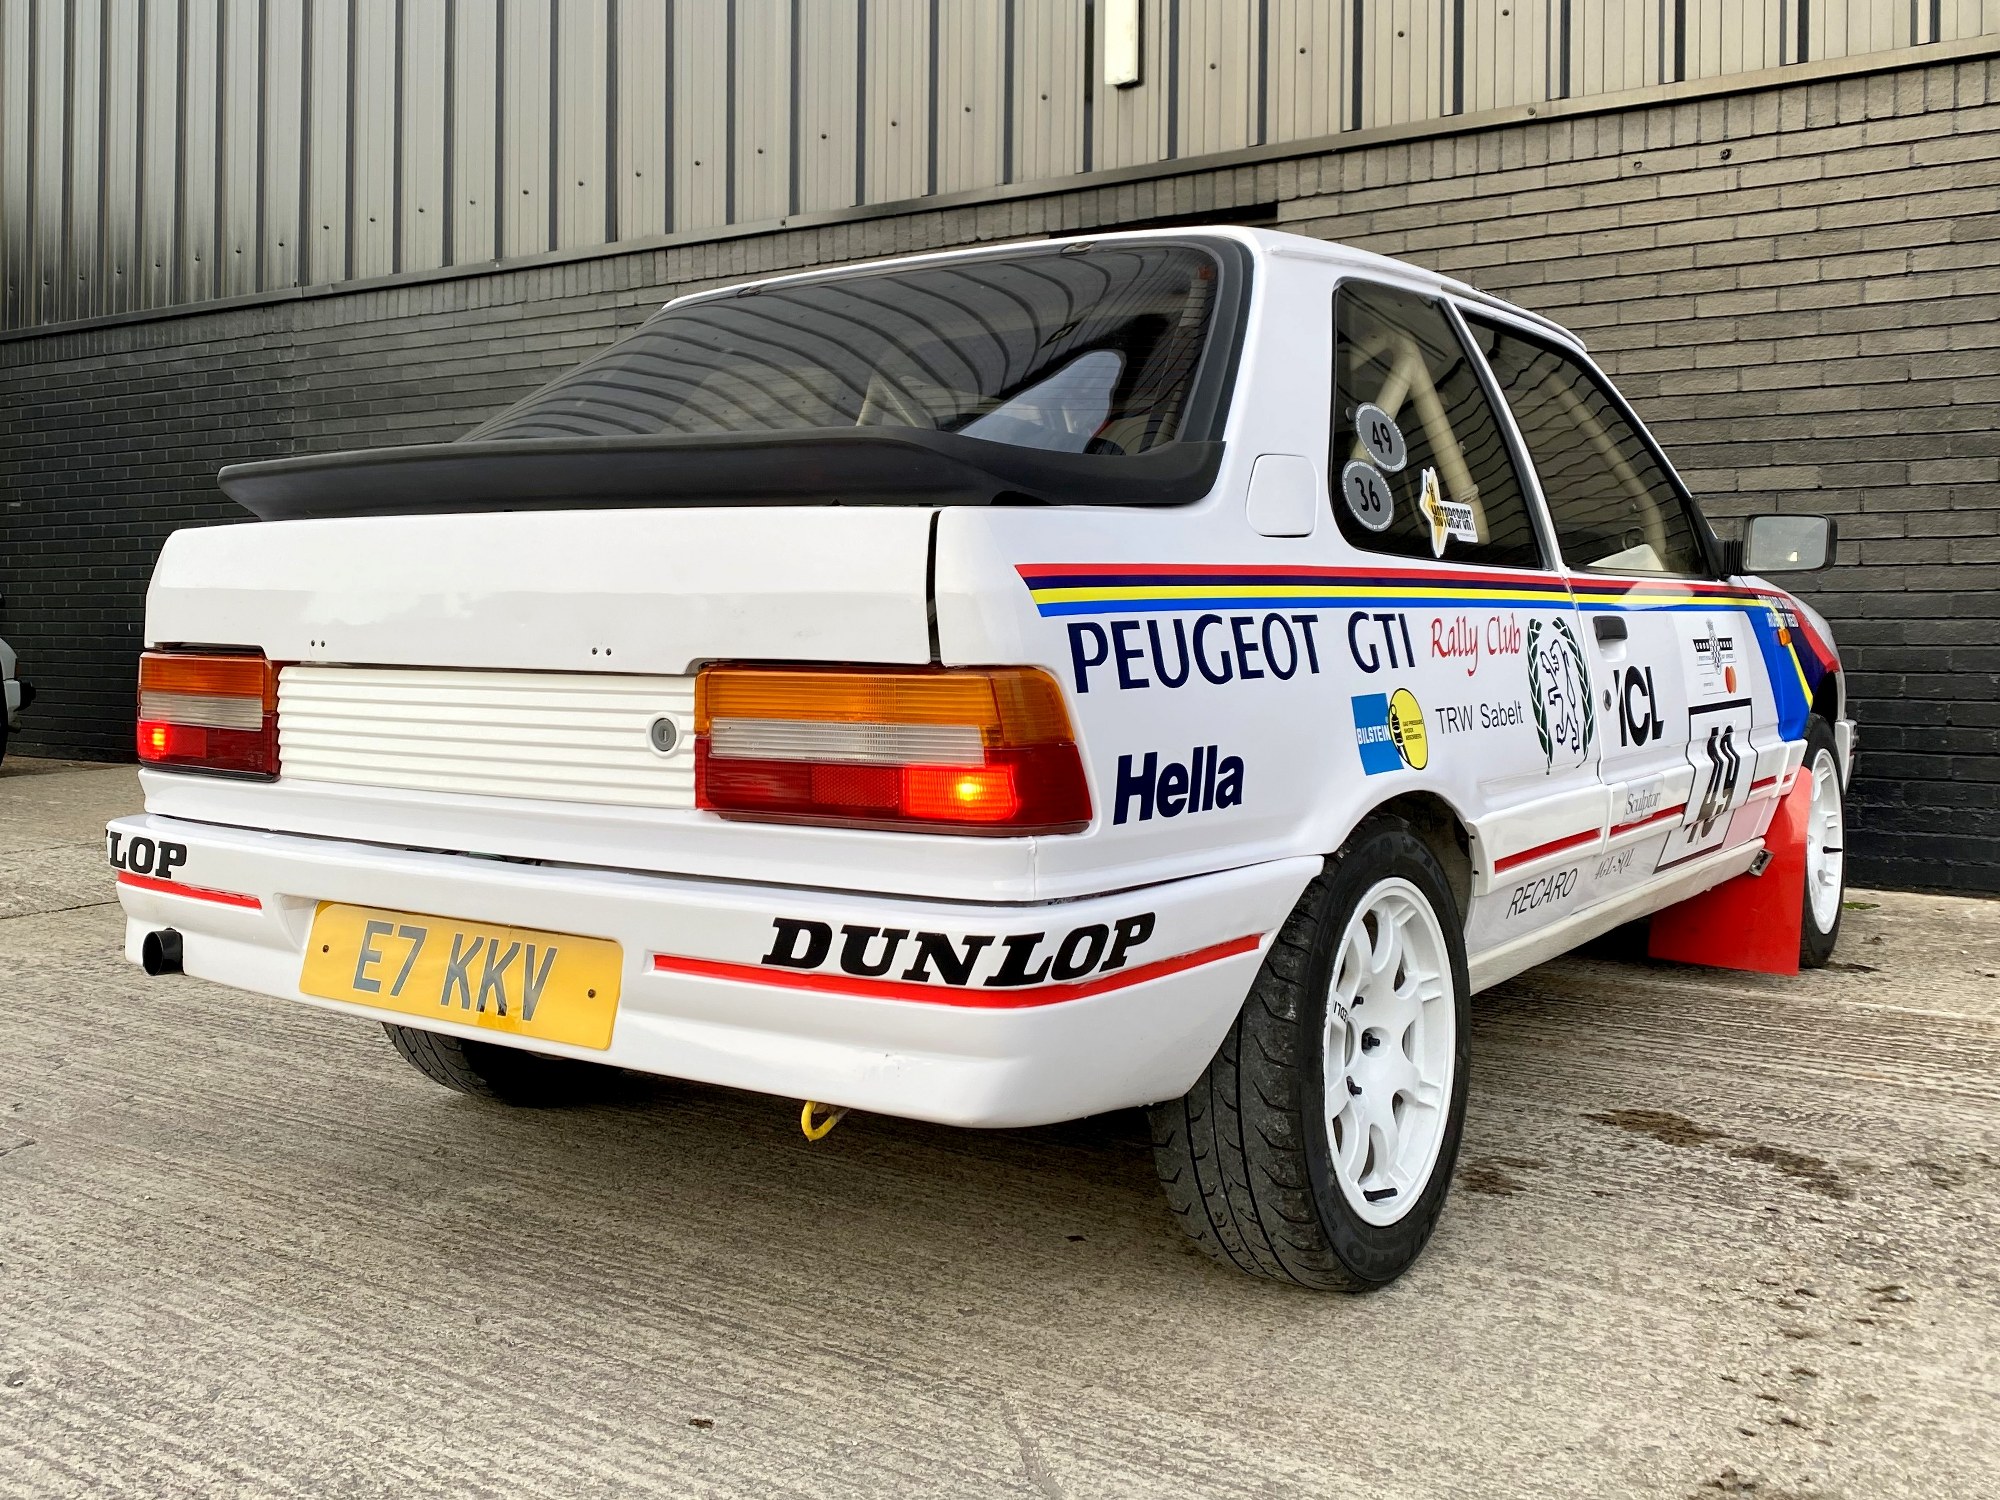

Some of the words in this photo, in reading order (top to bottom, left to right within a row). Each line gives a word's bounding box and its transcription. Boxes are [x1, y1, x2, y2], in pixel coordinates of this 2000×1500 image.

[1372, 421, 1393, 455] 49
[1354, 476, 1381, 512] 36
[1067, 612, 1320, 693] PEUGEOT
[1348, 610, 1416, 673] GTI
[1431, 615, 1479, 677] Rally
[1487, 611, 1522, 655] Club
[1435, 704, 1474, 735] TRW
[1480, 700, 1524, 729] Sabelt
[1613, 665, 1665, 748] ICL
[1356, 724, 1392, 745] BILSTEIN
[1113, 744, 1245, 826] Hella
[1625, 789, 1661, 817] Sculptor
[105, 829, 188, 879] LOP
[1506, 867, 1578, 919] RECARO
[352, 919, 428, 997] E7
[440, 932, 559, 1022] KKV
[760, 911, 1156, 988] DUNLOP
